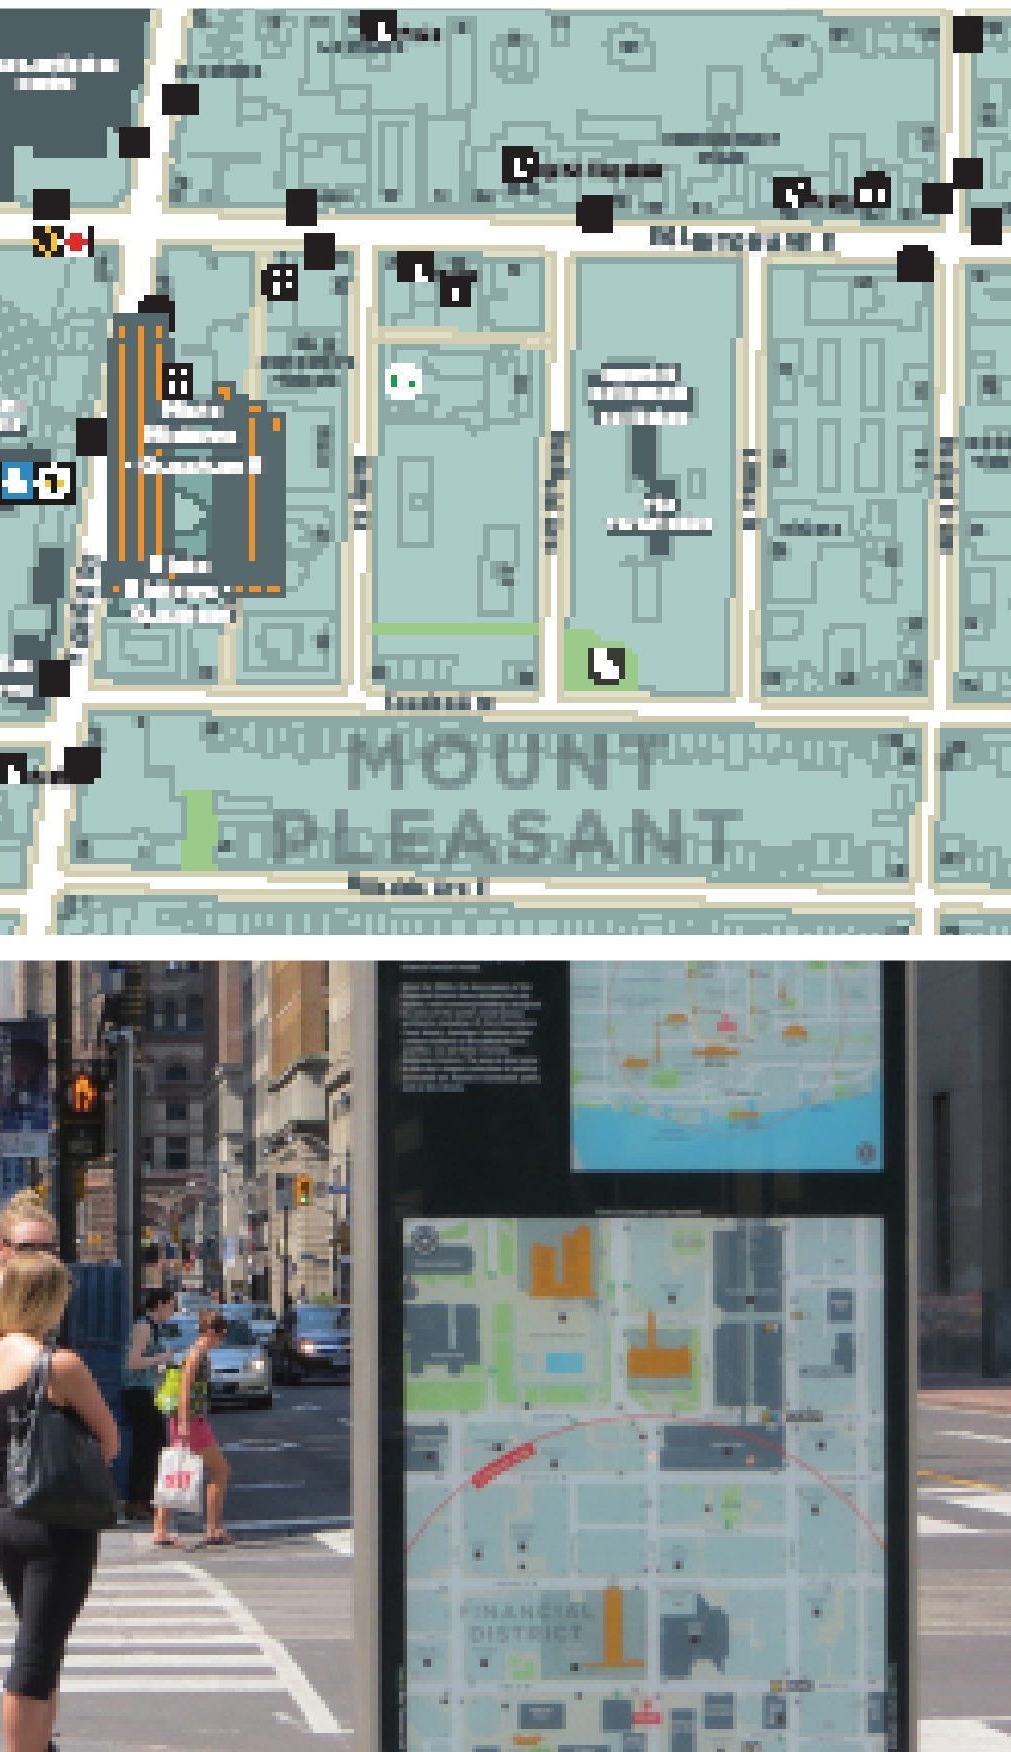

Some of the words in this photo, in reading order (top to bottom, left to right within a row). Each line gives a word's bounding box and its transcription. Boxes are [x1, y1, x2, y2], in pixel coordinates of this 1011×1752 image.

[347, 733, 669, 791] MOUNT
[271, 808, 743, 864] PLEASANT
[460, 1602, 595, 1619] FINANCIAL
[471, 1625, 583, 1643] DISTRICT
